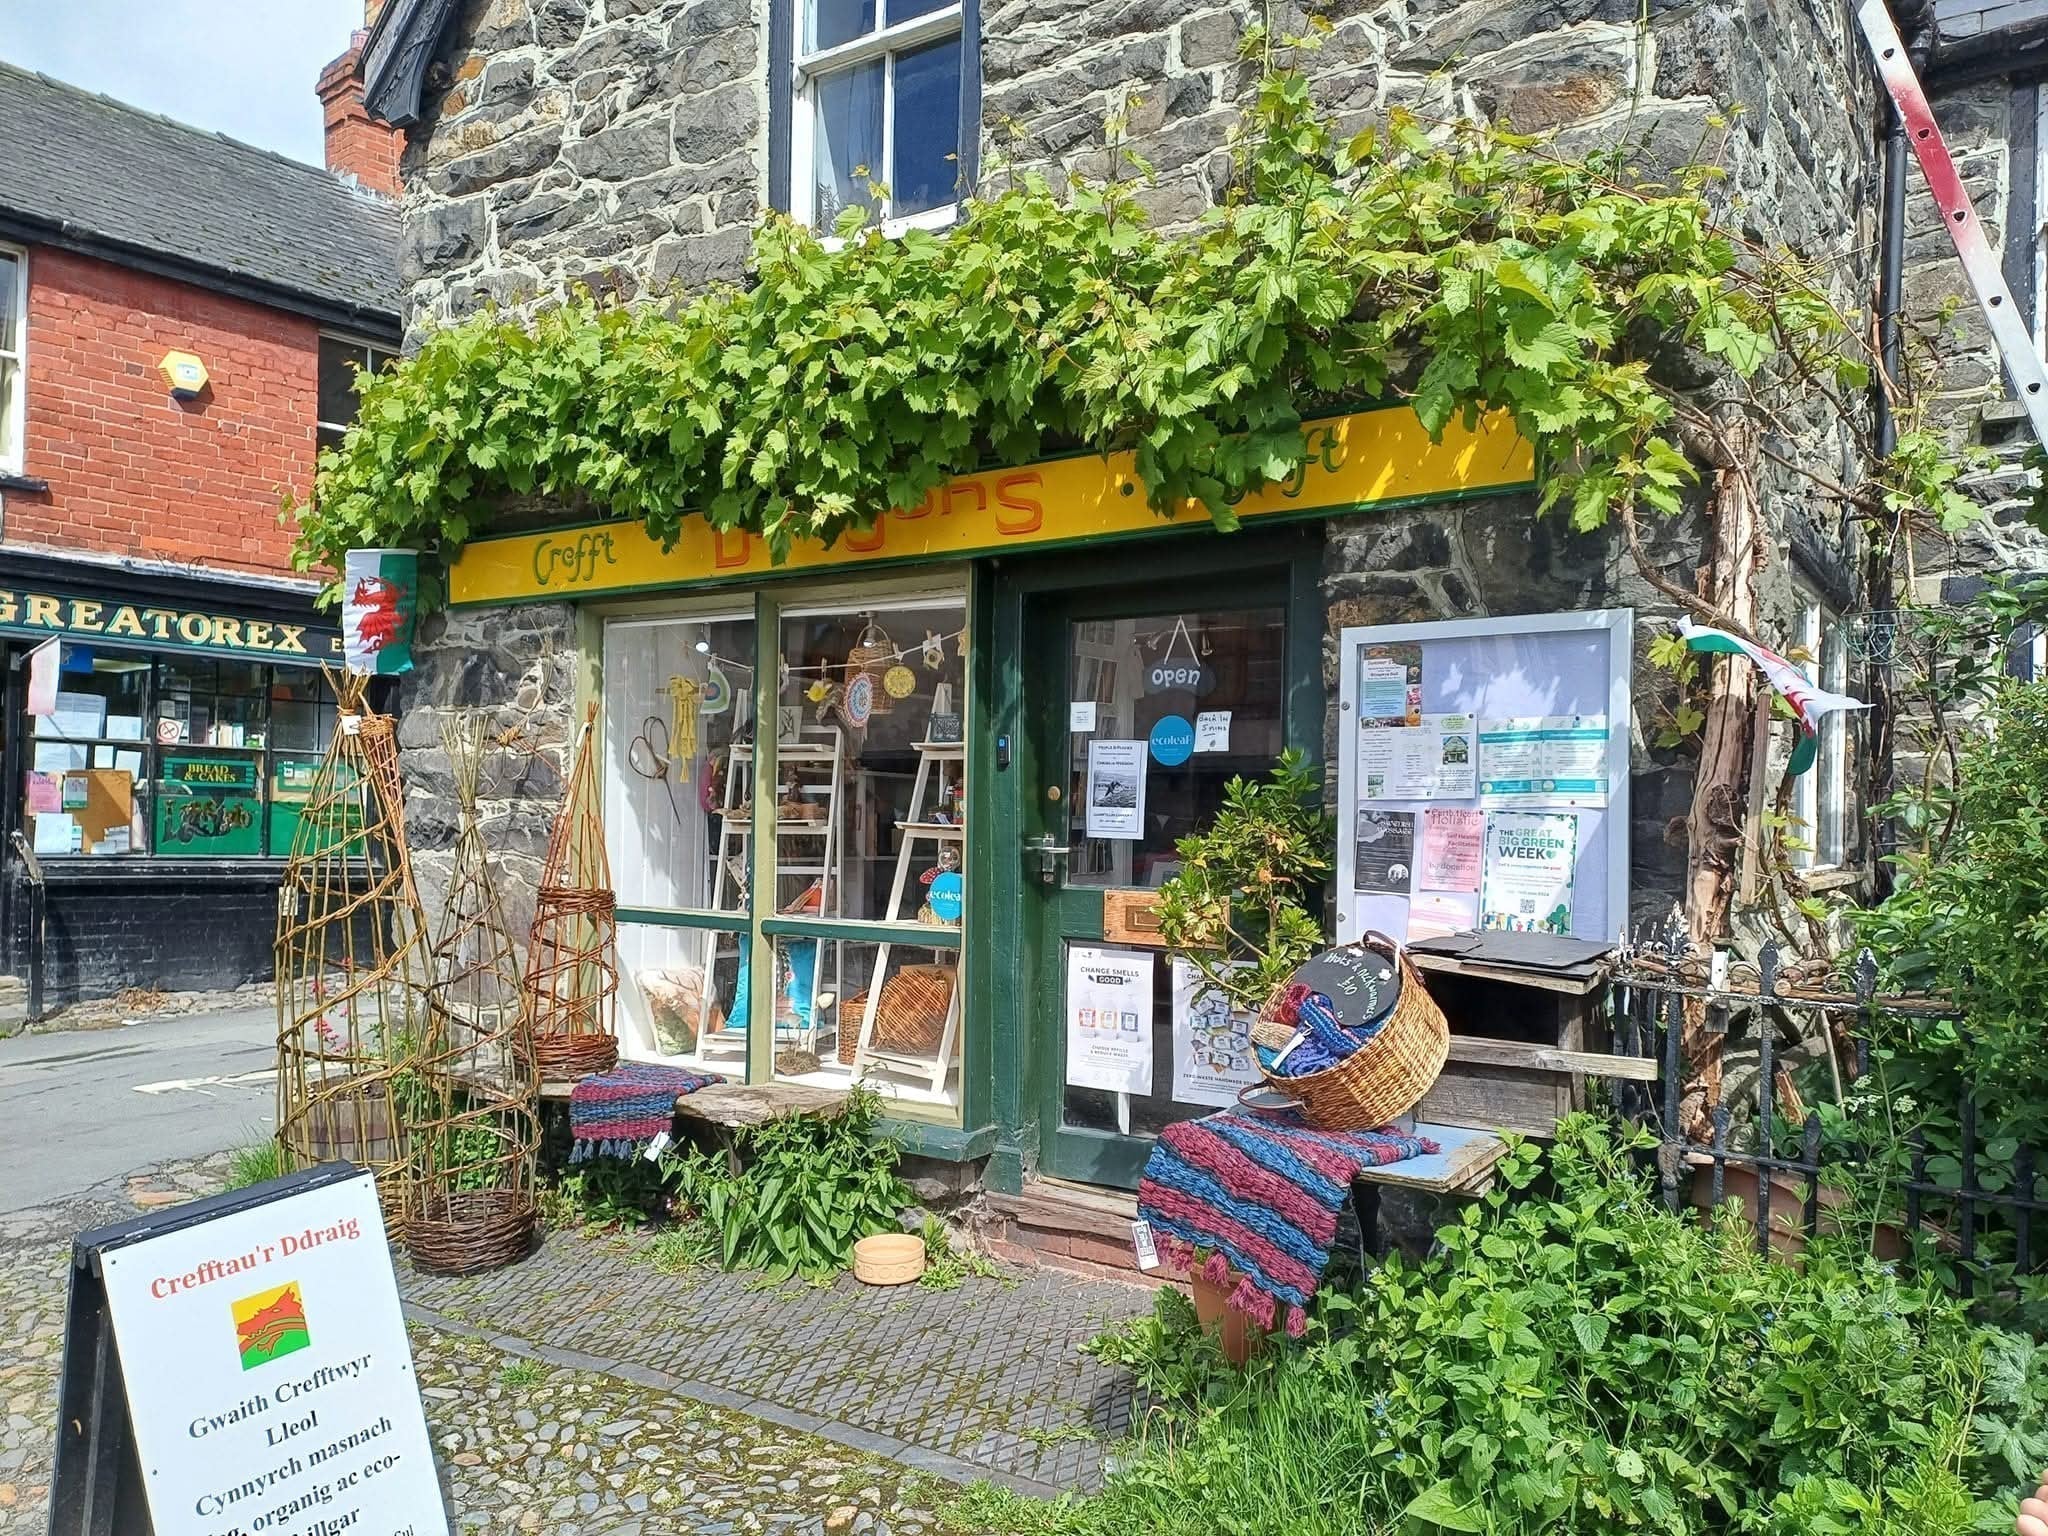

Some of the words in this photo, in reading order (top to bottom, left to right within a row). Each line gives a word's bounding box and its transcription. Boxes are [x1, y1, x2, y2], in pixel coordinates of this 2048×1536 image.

[532, 532, 617, 585] Crefft
[1152, 668, 1200, 687] open
[188, 763, 229, 774] BREAD
[184, 773, 193, 782] &
[199, 773, 236, 783] CAKES
[1515, 828, 1552, 837] GREAT
[1498, 837, 1519, 846] BIG
[1521, 838, 1565, 848] GREEN
[1498, 846, 1546, 859] WEEK
[930, 891, 961, 901] ecolea
[1323, 952, 1352, 967] Hats
[1080, 966, 1110, 975] CHANGE
[1112, 969, 1140, 977] SMELLS
[1098, 975, 1121, 984] GOOD
[1336, 975, 1358, 995] £10
[151, 1243, 275, 1300] Crefftau'r
[280, 1217, 361, 1257] Ddraig
[188, 1394, 269, 1439] Gwaith
[275, 1352, 373, 1404] Crefftwyr
[265, 1410, 320, 1448] Lleol
[195, 1456, 303, 1517] Cynnyrch
[309, 1416, 394, 1477] masnach
[252, 1485, 333, 1532] organig
[337, 1471, 360, 1493] ac
[363, 1454, 401, 1478] eco-
